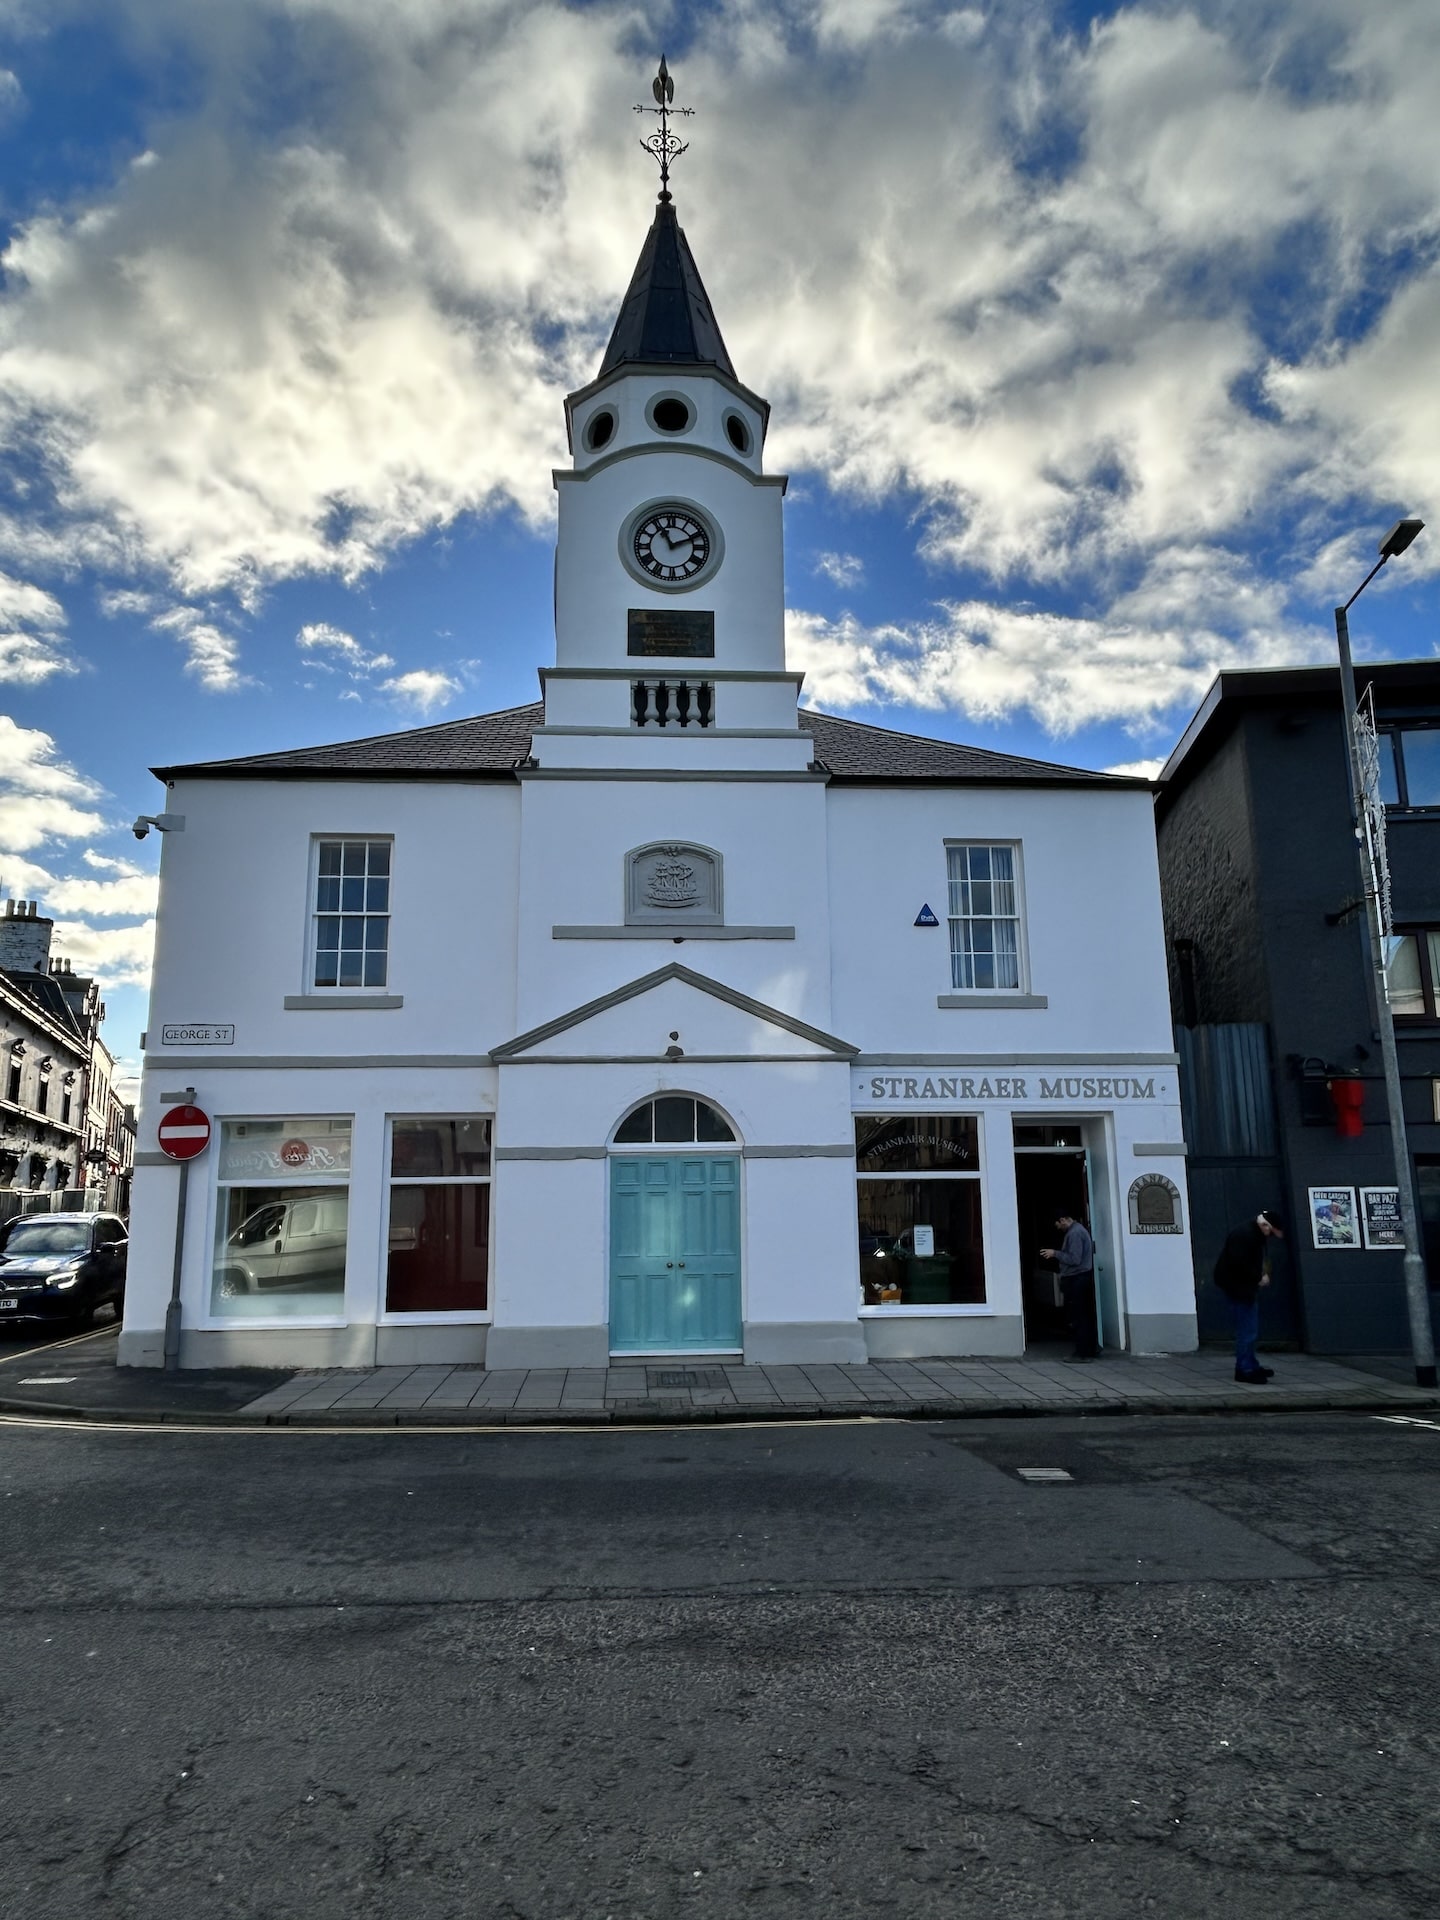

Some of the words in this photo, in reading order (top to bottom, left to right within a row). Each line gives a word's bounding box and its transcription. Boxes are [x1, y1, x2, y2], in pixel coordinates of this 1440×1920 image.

[165, 1029, 210, 1039] GEORGE
[215, 1029, 229, 1039] ST
[870, 1077, 1028, 1098] STRANRAER
[1039, 1078, 1156, 1099] MUSEUM
[866, 1135, 925, 1159] STRANRAER
[927, 1136, 969, 1159] MUSEUM
[1129, 1174, 1180, 1199] STRANRAER
